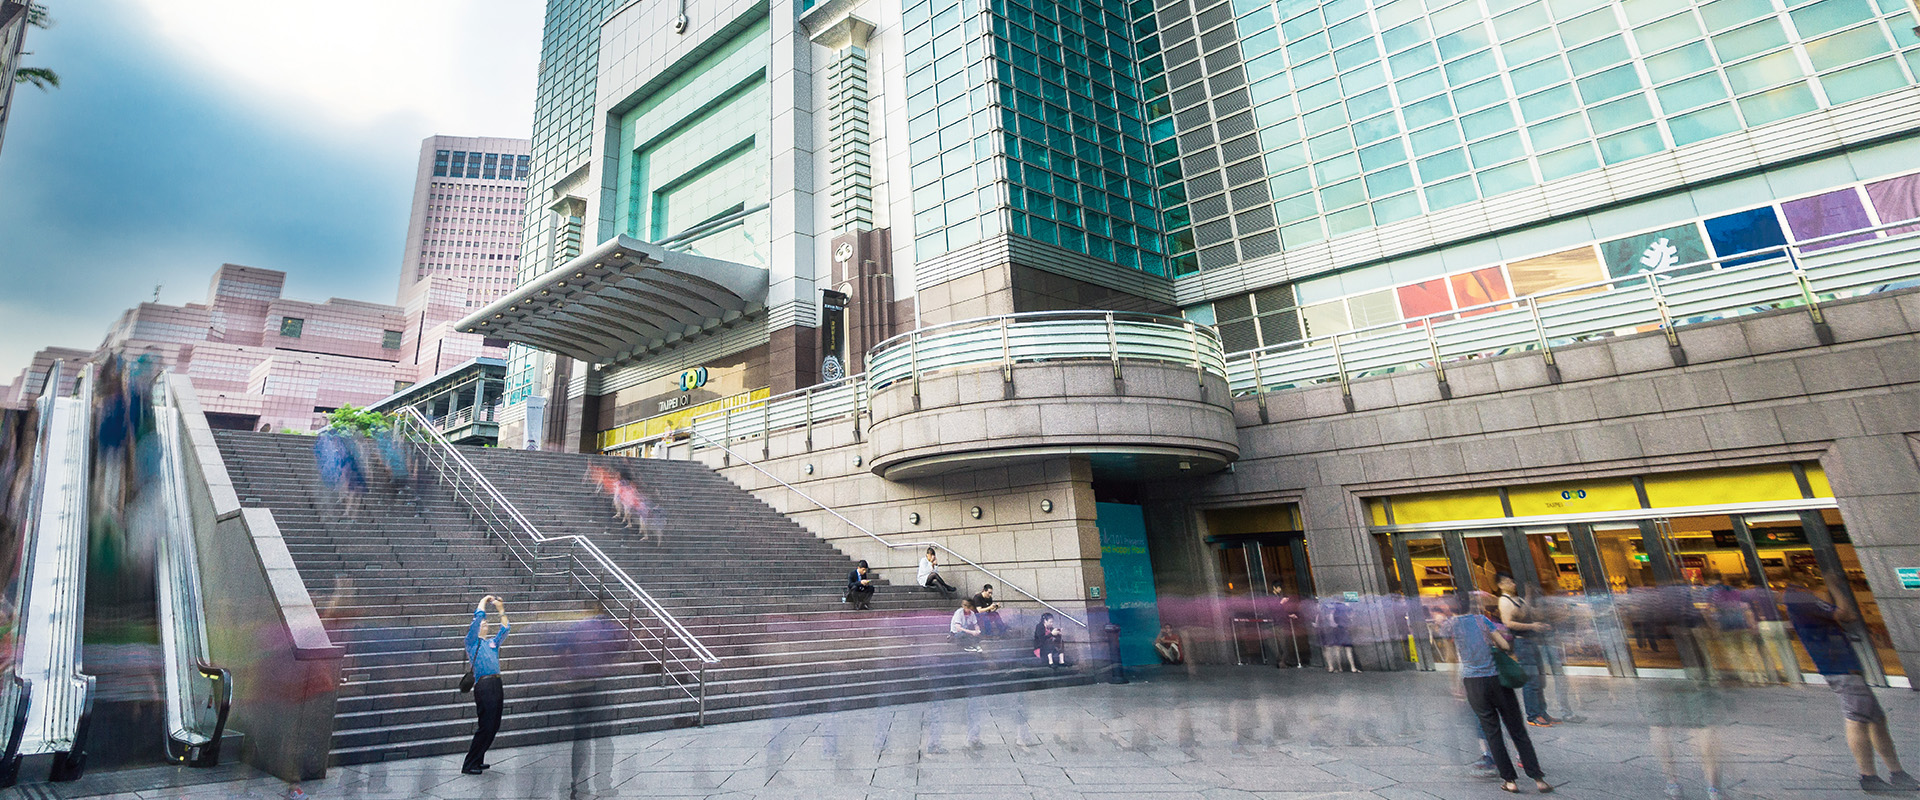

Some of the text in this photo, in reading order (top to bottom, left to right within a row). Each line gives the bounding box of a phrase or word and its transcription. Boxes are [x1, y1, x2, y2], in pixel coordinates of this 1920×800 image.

[658, 394, 691, 412] TAIPEI 101
[1561, 489, 1587, 500] 101
